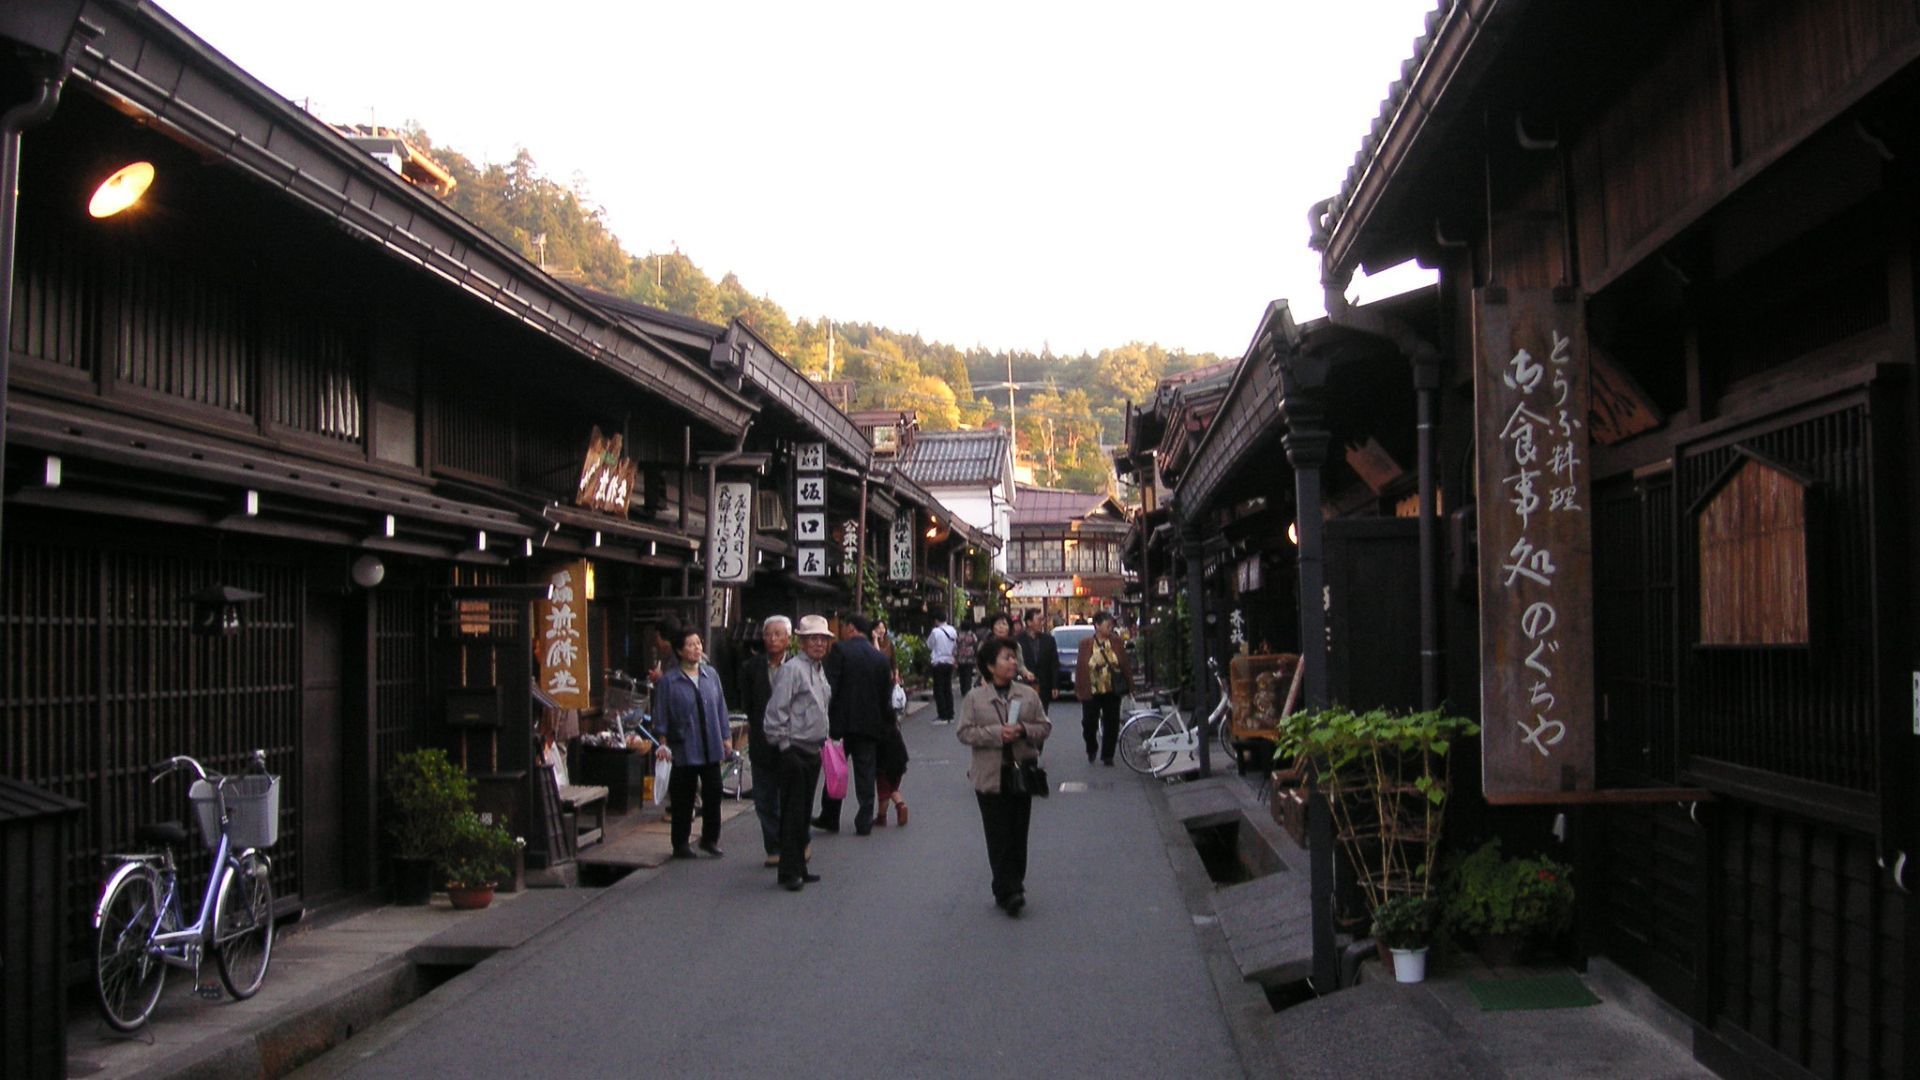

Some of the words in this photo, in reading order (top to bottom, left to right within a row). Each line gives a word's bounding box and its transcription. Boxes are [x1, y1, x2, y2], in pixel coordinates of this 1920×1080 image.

[1546, 329, 1582, 511] とうふ料理
[800, 482, 821, 573] 坂口屋
